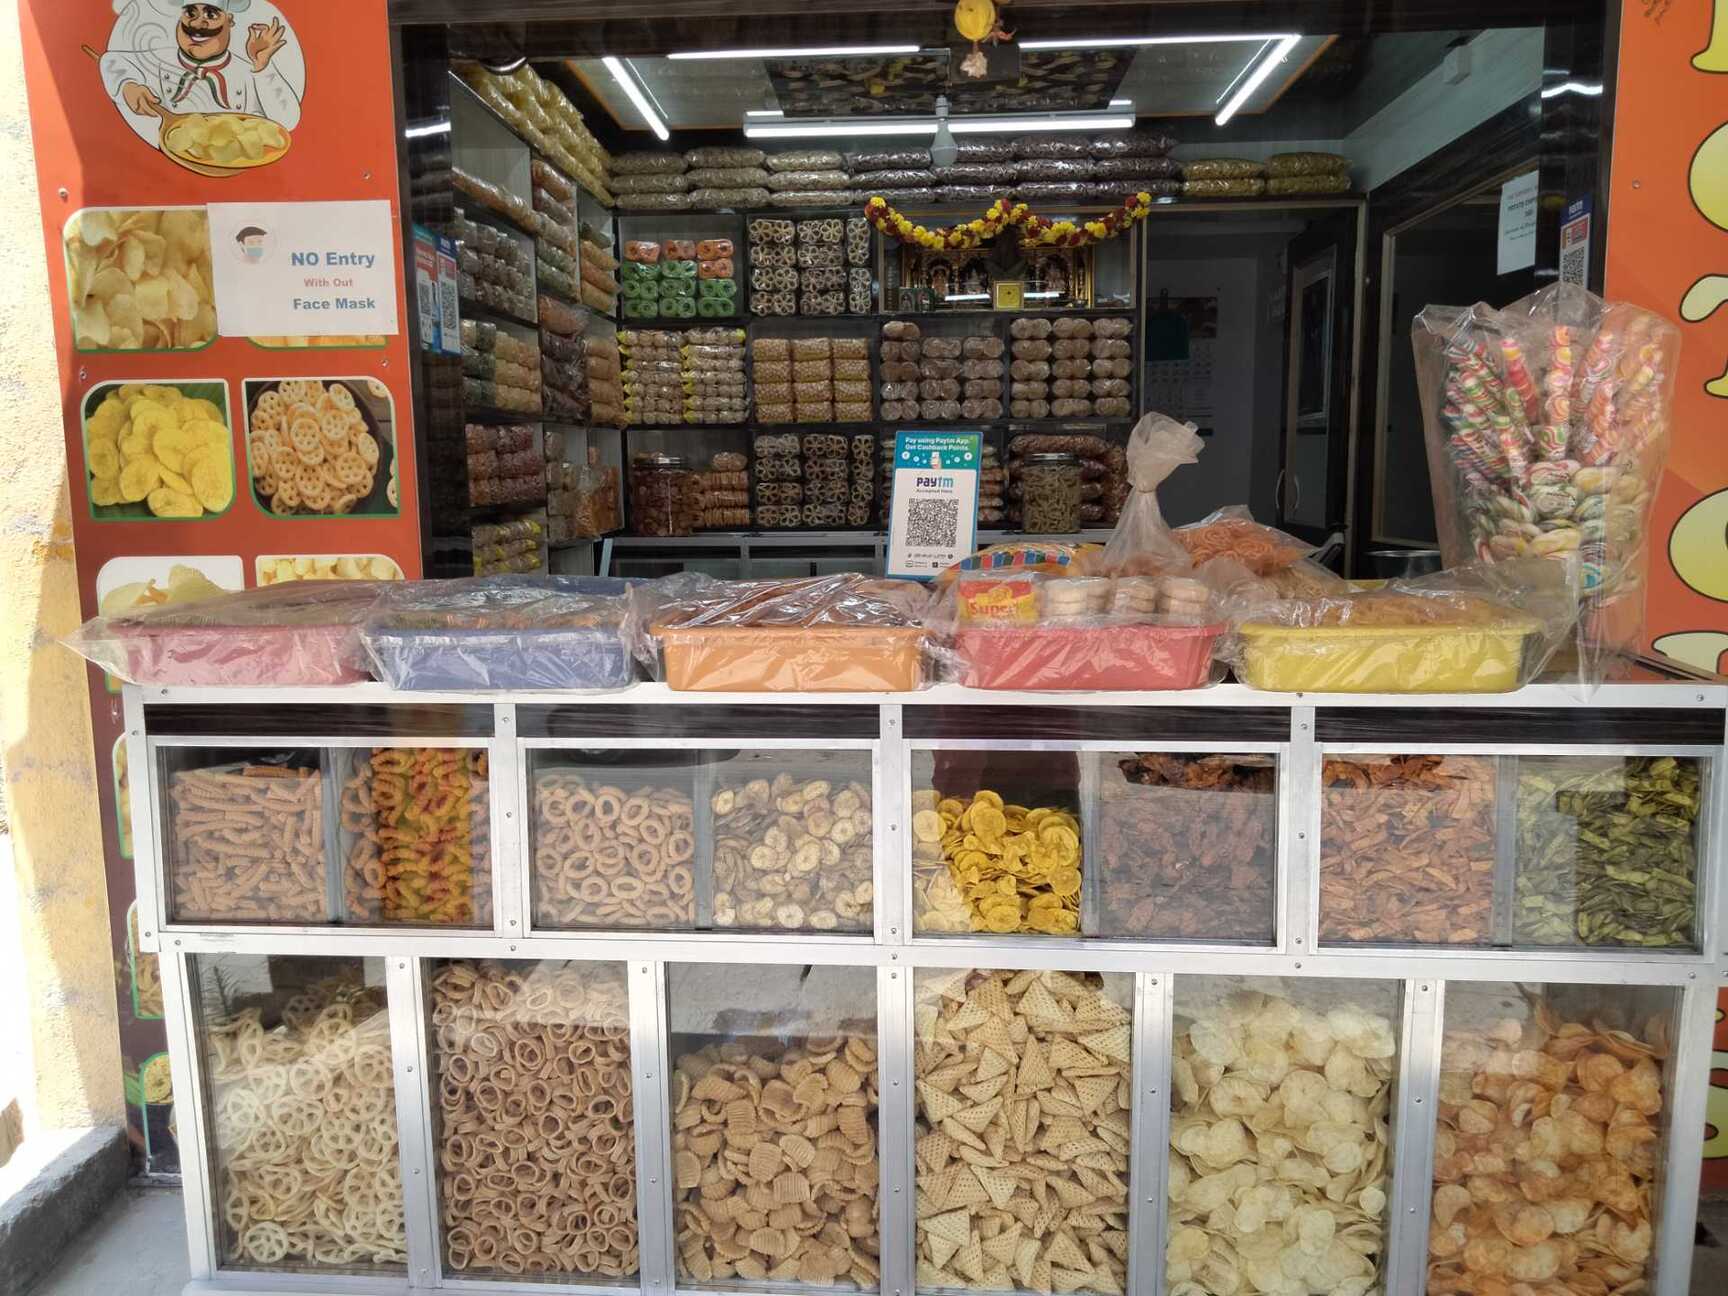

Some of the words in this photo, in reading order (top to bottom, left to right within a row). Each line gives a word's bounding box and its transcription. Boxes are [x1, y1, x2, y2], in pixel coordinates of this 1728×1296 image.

[291, 251, 319, 266] NO
[326, 251, 375, 269] Entry
[304, 277, 330, 287] With
[333, 277, 353, 287] Out
[293, 298, 331, 310] Face
[335, 297, 375, 309] Mask
